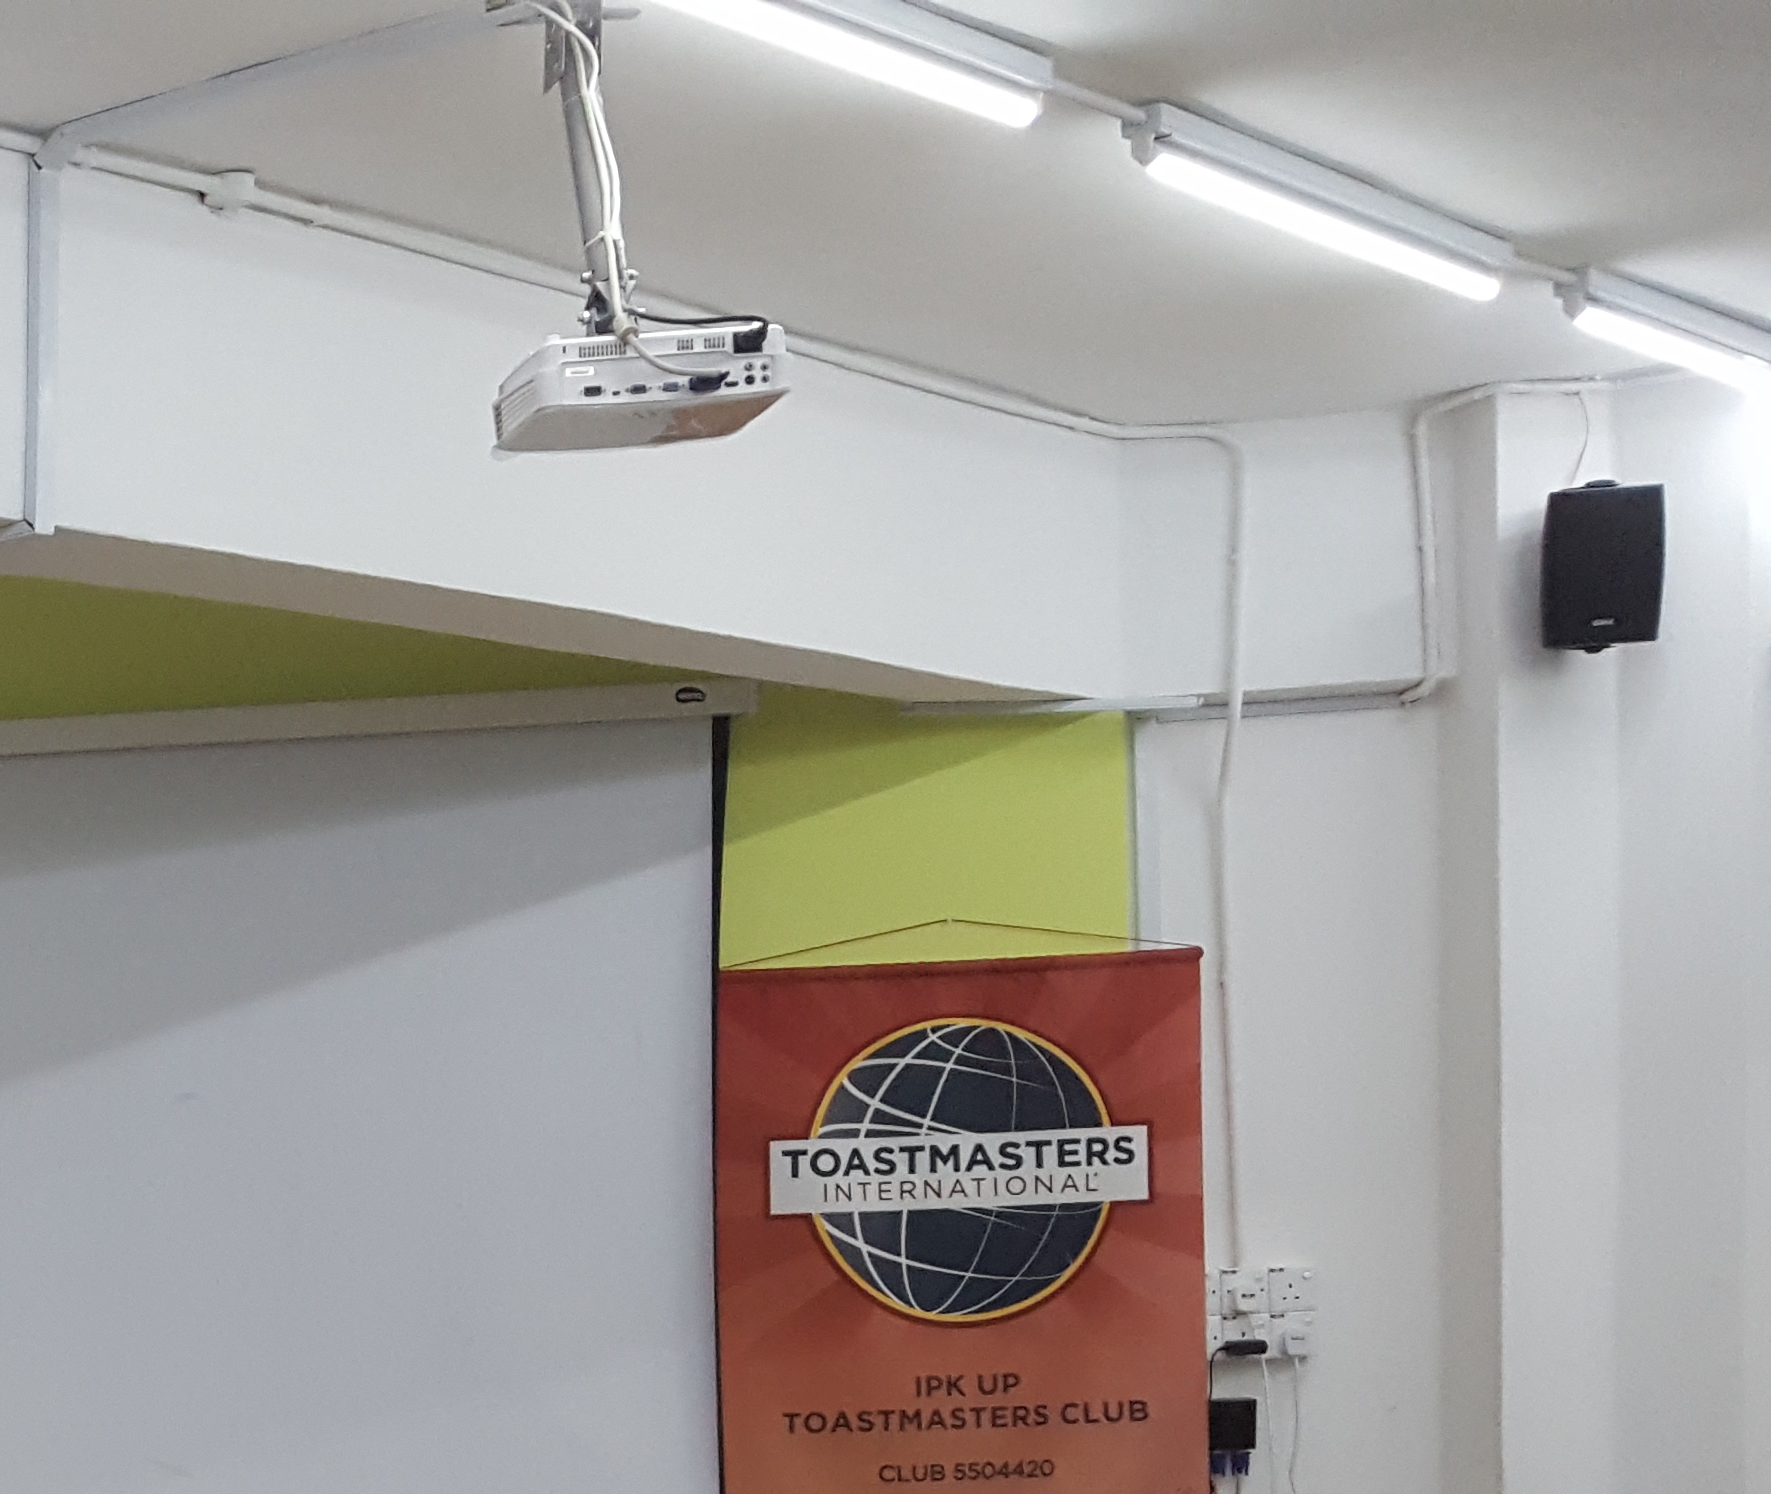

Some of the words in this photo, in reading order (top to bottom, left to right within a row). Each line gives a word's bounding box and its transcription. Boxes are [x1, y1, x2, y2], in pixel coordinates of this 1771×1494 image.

[781, 1135, 1137, 1179] TOASTMASTERS
[822, 1173, 1100, 1203] INTERNATIONAL
[914, 1374, 967, 1399] IPK
[976, 1372, 1022, 1397] UP
[781, 1403, 1050, 1435] TOASTMASTERS
[1060, 1399, 1151, 1425] CLUB
[878, 1462, 947, 1483] CLUB
[953, 1457, 1056, 1481] 5504420
